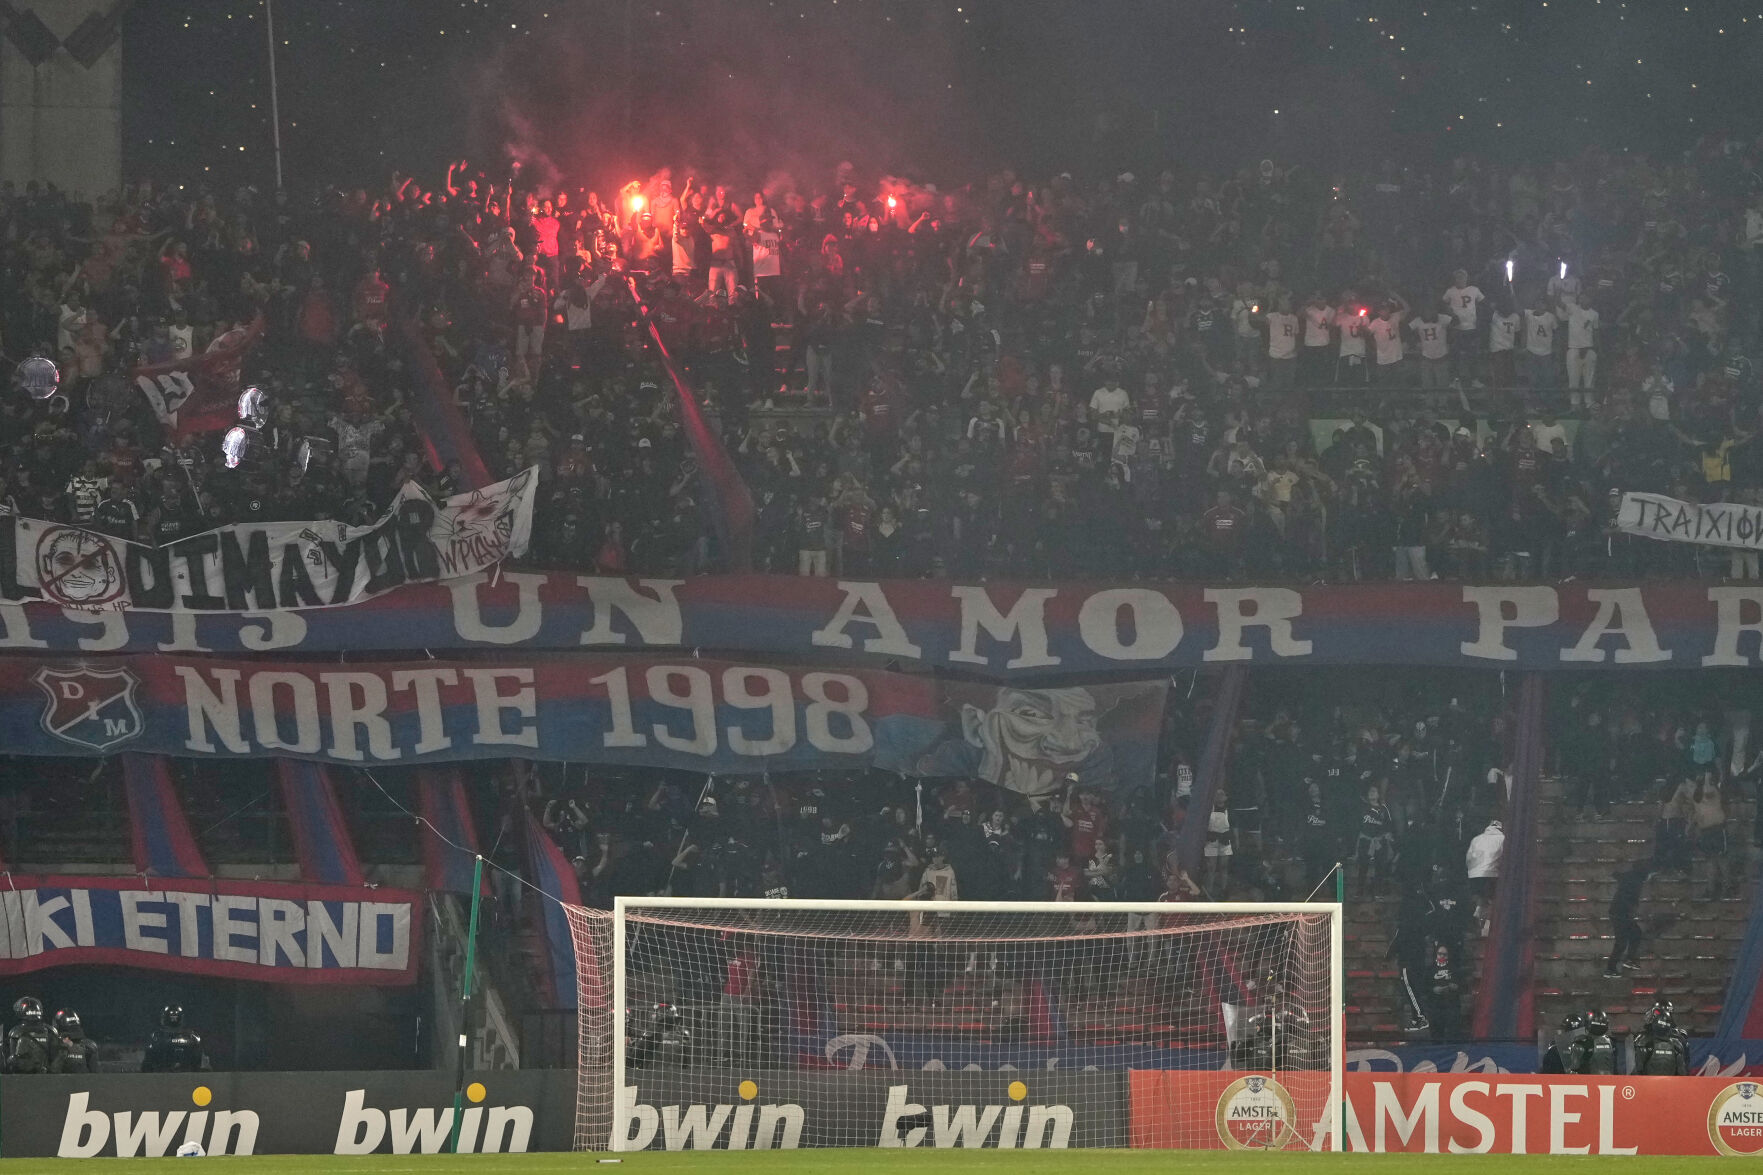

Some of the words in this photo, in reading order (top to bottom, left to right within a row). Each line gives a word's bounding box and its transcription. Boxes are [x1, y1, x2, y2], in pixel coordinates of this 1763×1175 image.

[439, 571, 686, 645] UN
[812, 581, 1312, 669] AMOR
[174, 665, 539, 761] NORTE
[590, 665, 875, 757] 1998
[119, 890, 412, 971] ETERNO
[57, 1086, 260, 1158] bwin
[334, 1083, 534, 1155] bwin
[608, 1080, 805, 1151] bwin
[878, 1080, 1075, 1149] bwin
[1731, 1128, 1762, 1137] LAGER
